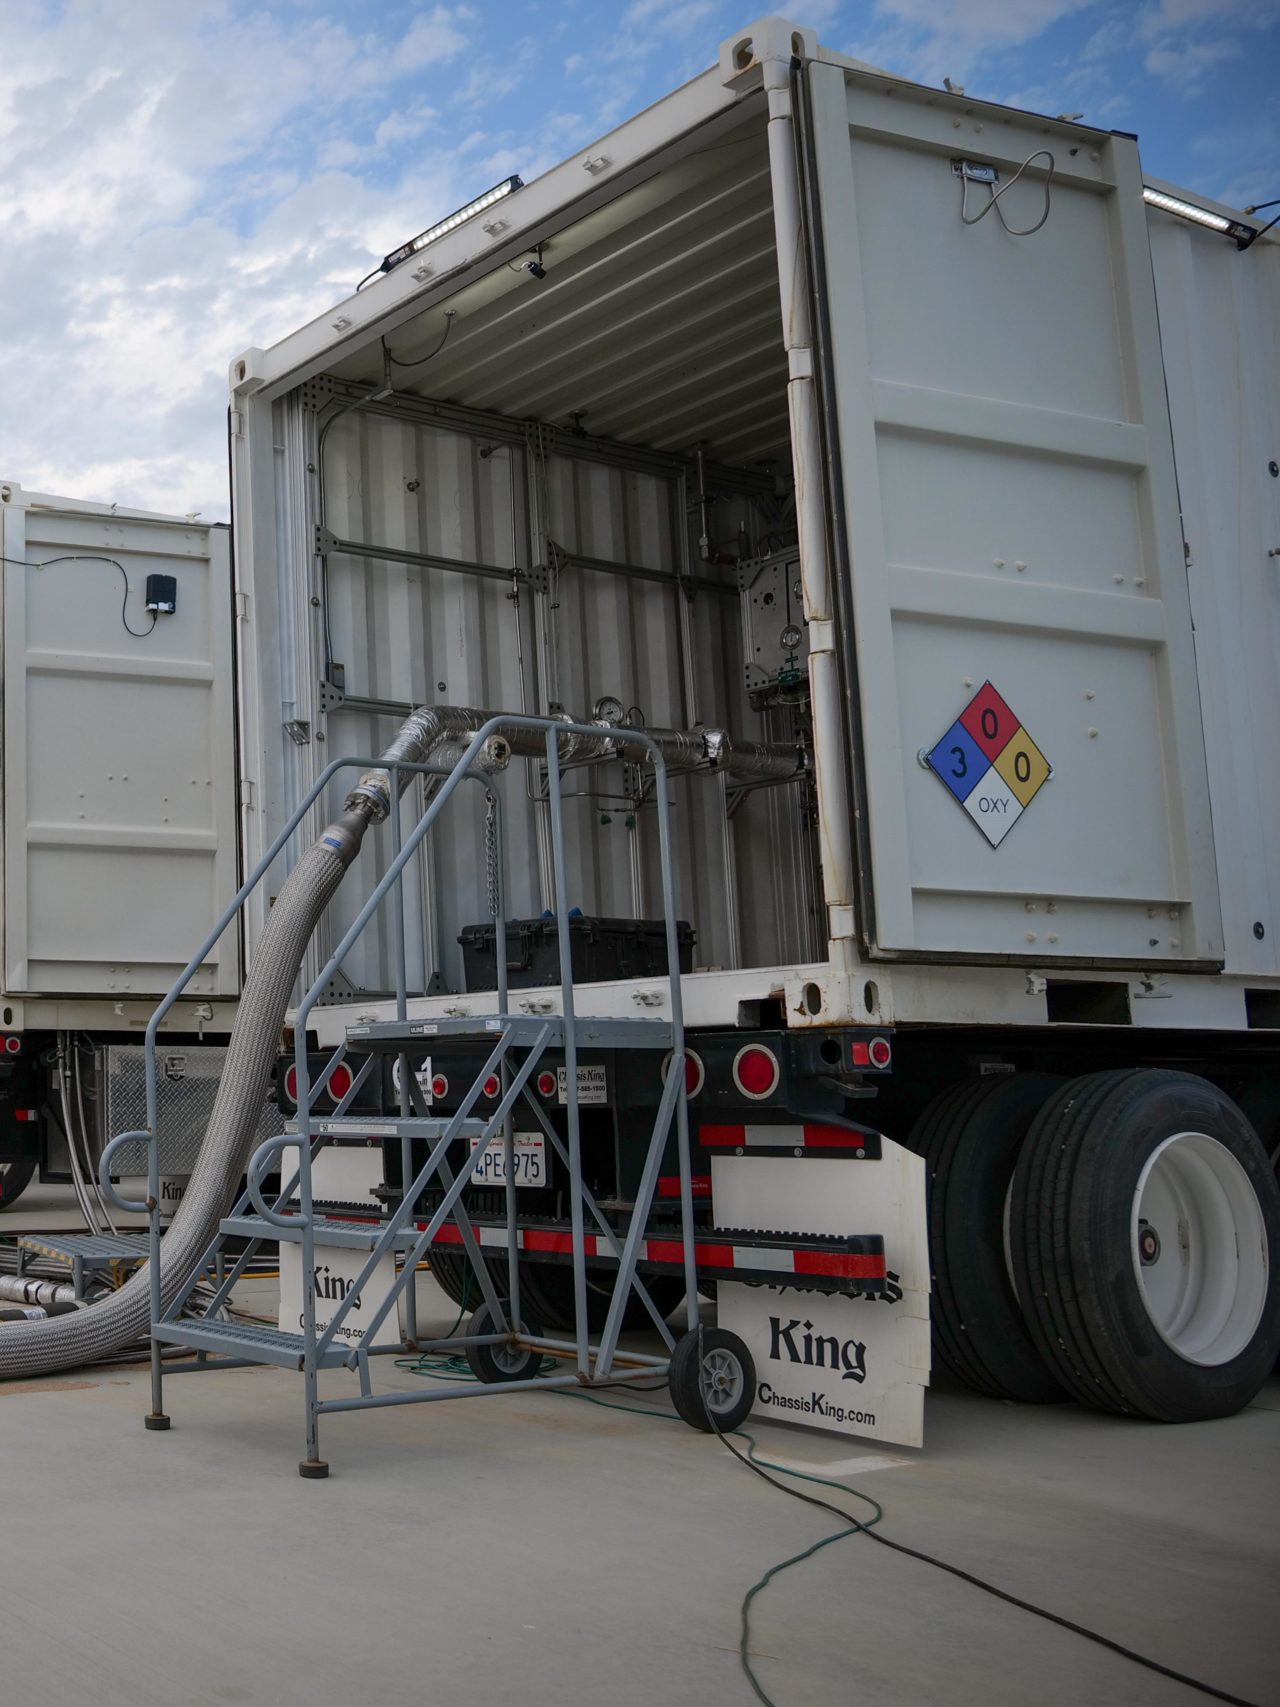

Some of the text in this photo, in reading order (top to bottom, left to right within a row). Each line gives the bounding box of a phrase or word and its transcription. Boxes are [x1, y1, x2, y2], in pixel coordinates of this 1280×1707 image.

[981, 708, 999, 740] 0
[950, 746, 1031, 783] 3 0
[978, 797, 1010, 814] OXY
[558, 1069, 605, 1082] Chsis King
[769, 1316, 867, 1384] King
[758, 1382, 876, 1426] ChassisKing.com
